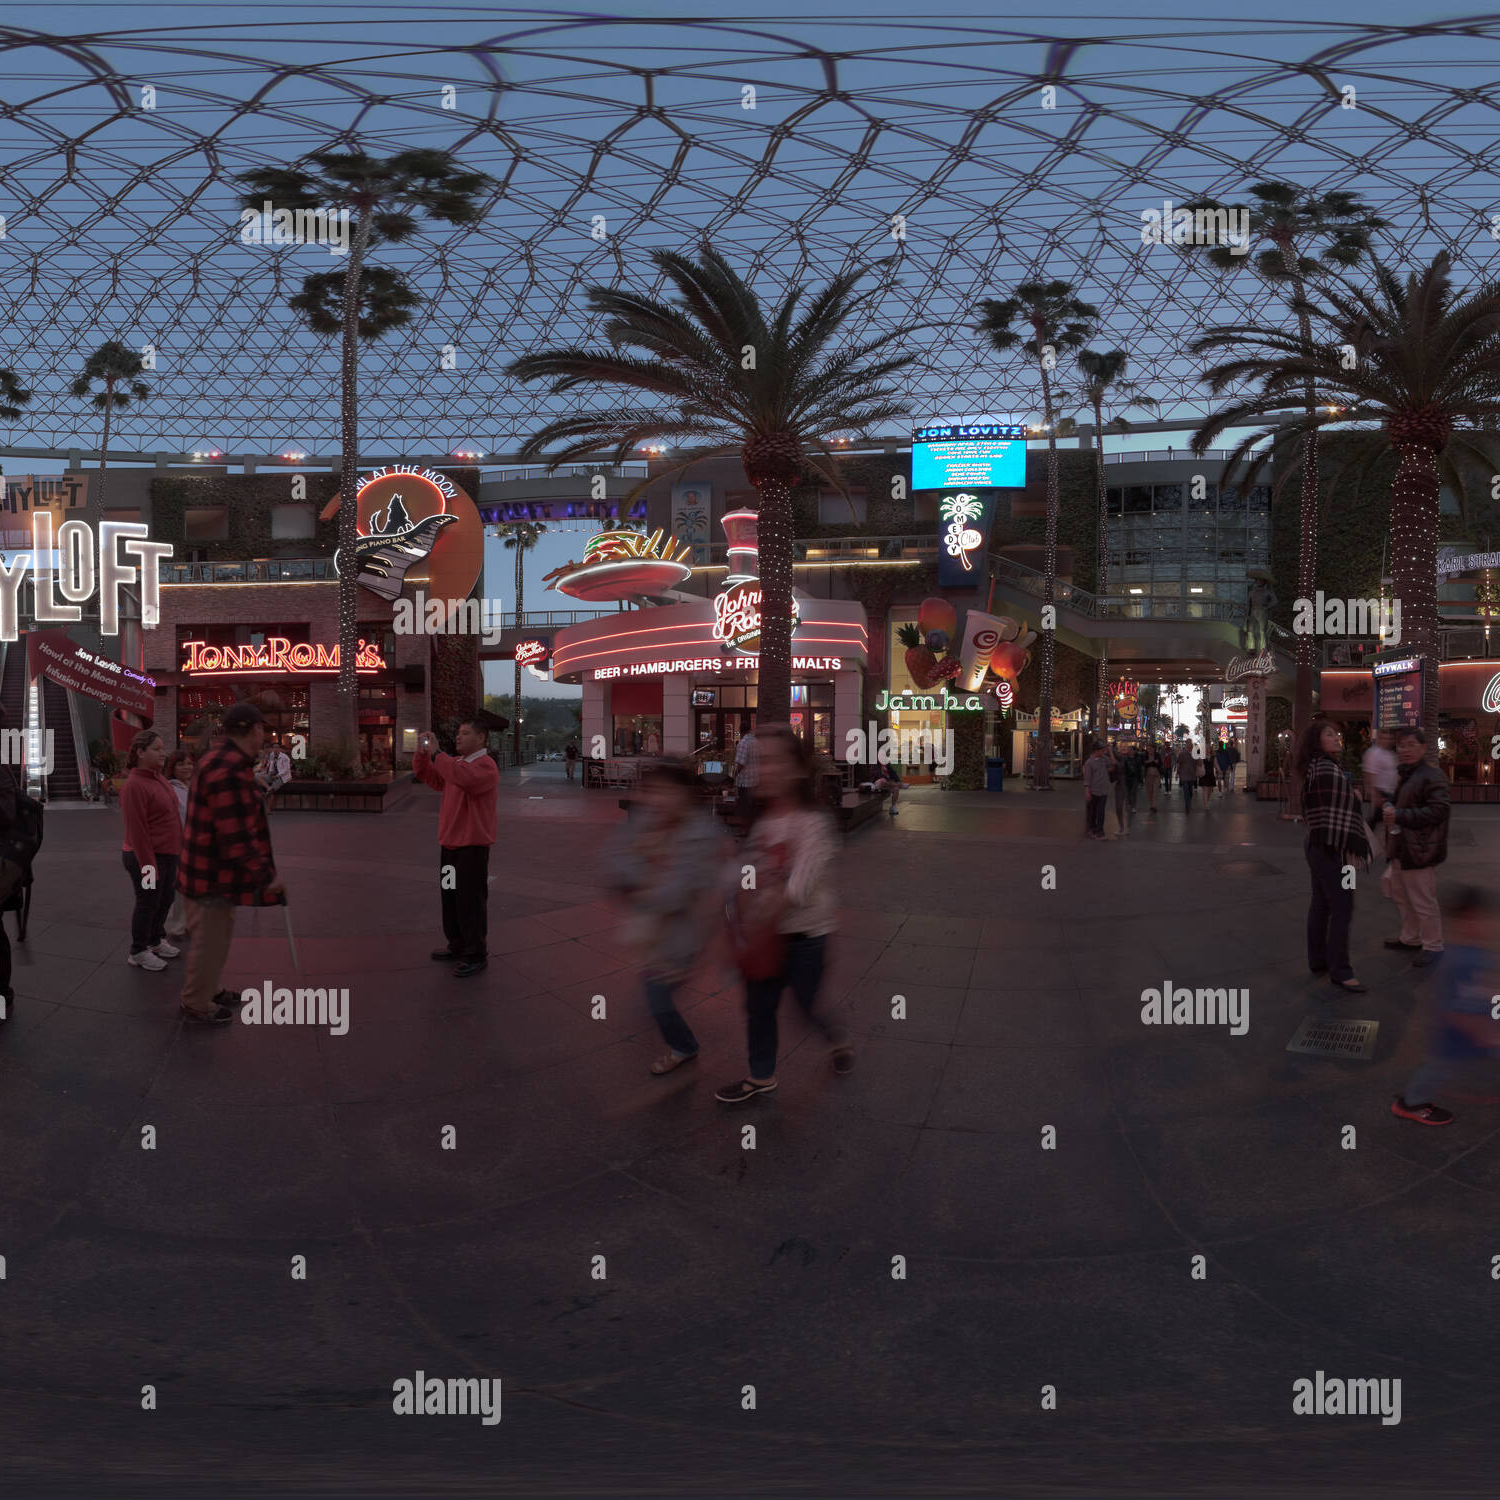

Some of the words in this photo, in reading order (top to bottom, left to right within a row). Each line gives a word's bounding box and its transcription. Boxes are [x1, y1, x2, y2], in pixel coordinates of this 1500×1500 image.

[917, 428, 953, 438] JON
[958, 426, 1022, 436] LOVITZ
[373, 466, 387, 480] AT
[393, 463, 421, 476] THE
[421, 468, 458, 499] MOON
[949, 495, 966, 554] COMEDY
[38, 642, 64, 662] Howl
[62, 657, 73, 668] at
[74, 661, 91, 676] the
[90, 670, 118, 688] Moon
[268, 637, 380, 672] ROM'S
[594, 667, 621, 681] BEER
[630, 658, 722, 676] HAMBURGERS
[736, 658, 760, 669] FRI
[792, 657, 842, 670] MALTS
[1374, 661, 1414, 675] CITYWALK
[46, 664, 80, 689] Infusion
[80, 681, 113, 702] Lounge
[875, 687, 984, 711] Jamba
[1251, 680, 1260, 755] CANTINA
